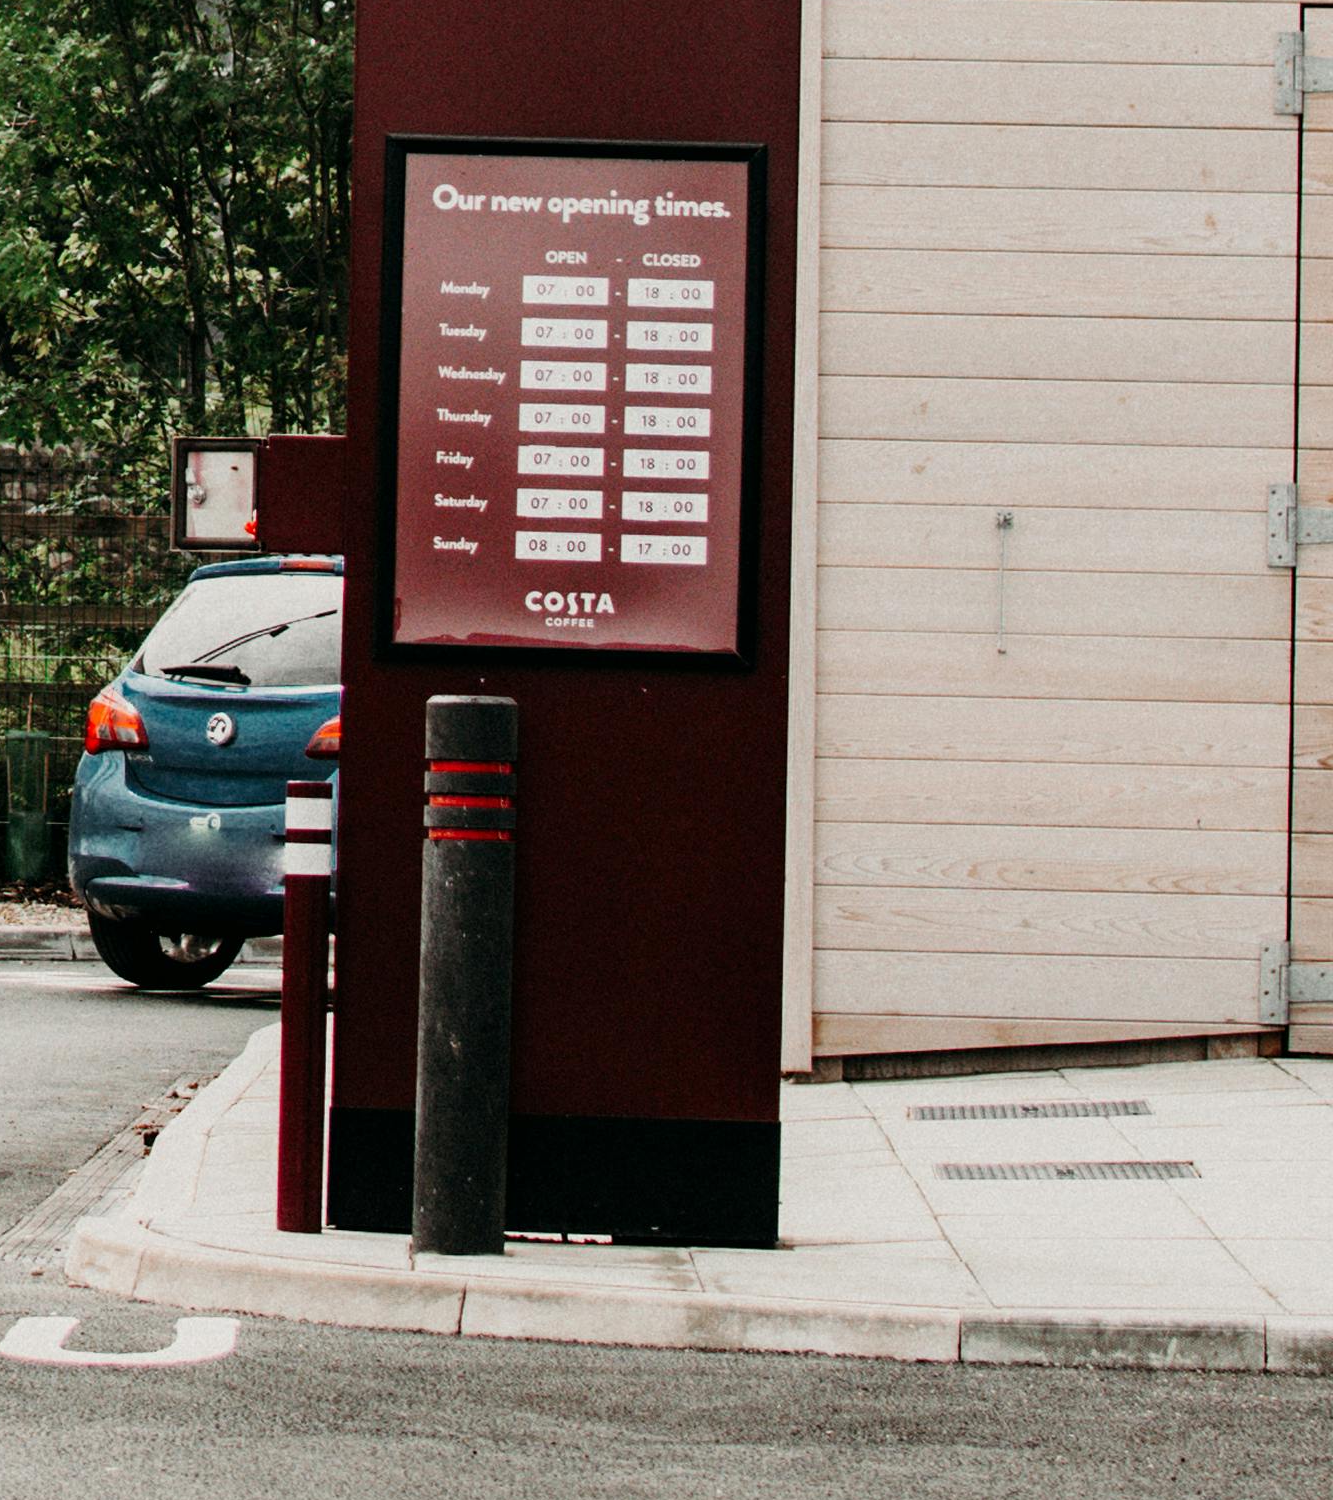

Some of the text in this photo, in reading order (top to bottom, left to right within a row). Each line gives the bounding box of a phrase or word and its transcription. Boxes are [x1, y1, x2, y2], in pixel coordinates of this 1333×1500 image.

[433, 184, 731, 226] Our new opening times.
[545, 250, 588, 265] OPEN
[642, 253, 702, 268] CLOSED
[440, 280, 490, 299] Monday
[439, 323, 487, 342] Tuesday
[438, 365, 506, 384] Wednesday
[437, 408, 492, 427] Thursday
[436, 451, 474, 469] Friday
[434, 493, 488, 512] Saturday
[433, 536, 479, 554] Sunday
[524, 591, 615, 615] COSTA
[545, 617, 595, 628] COFFEE
